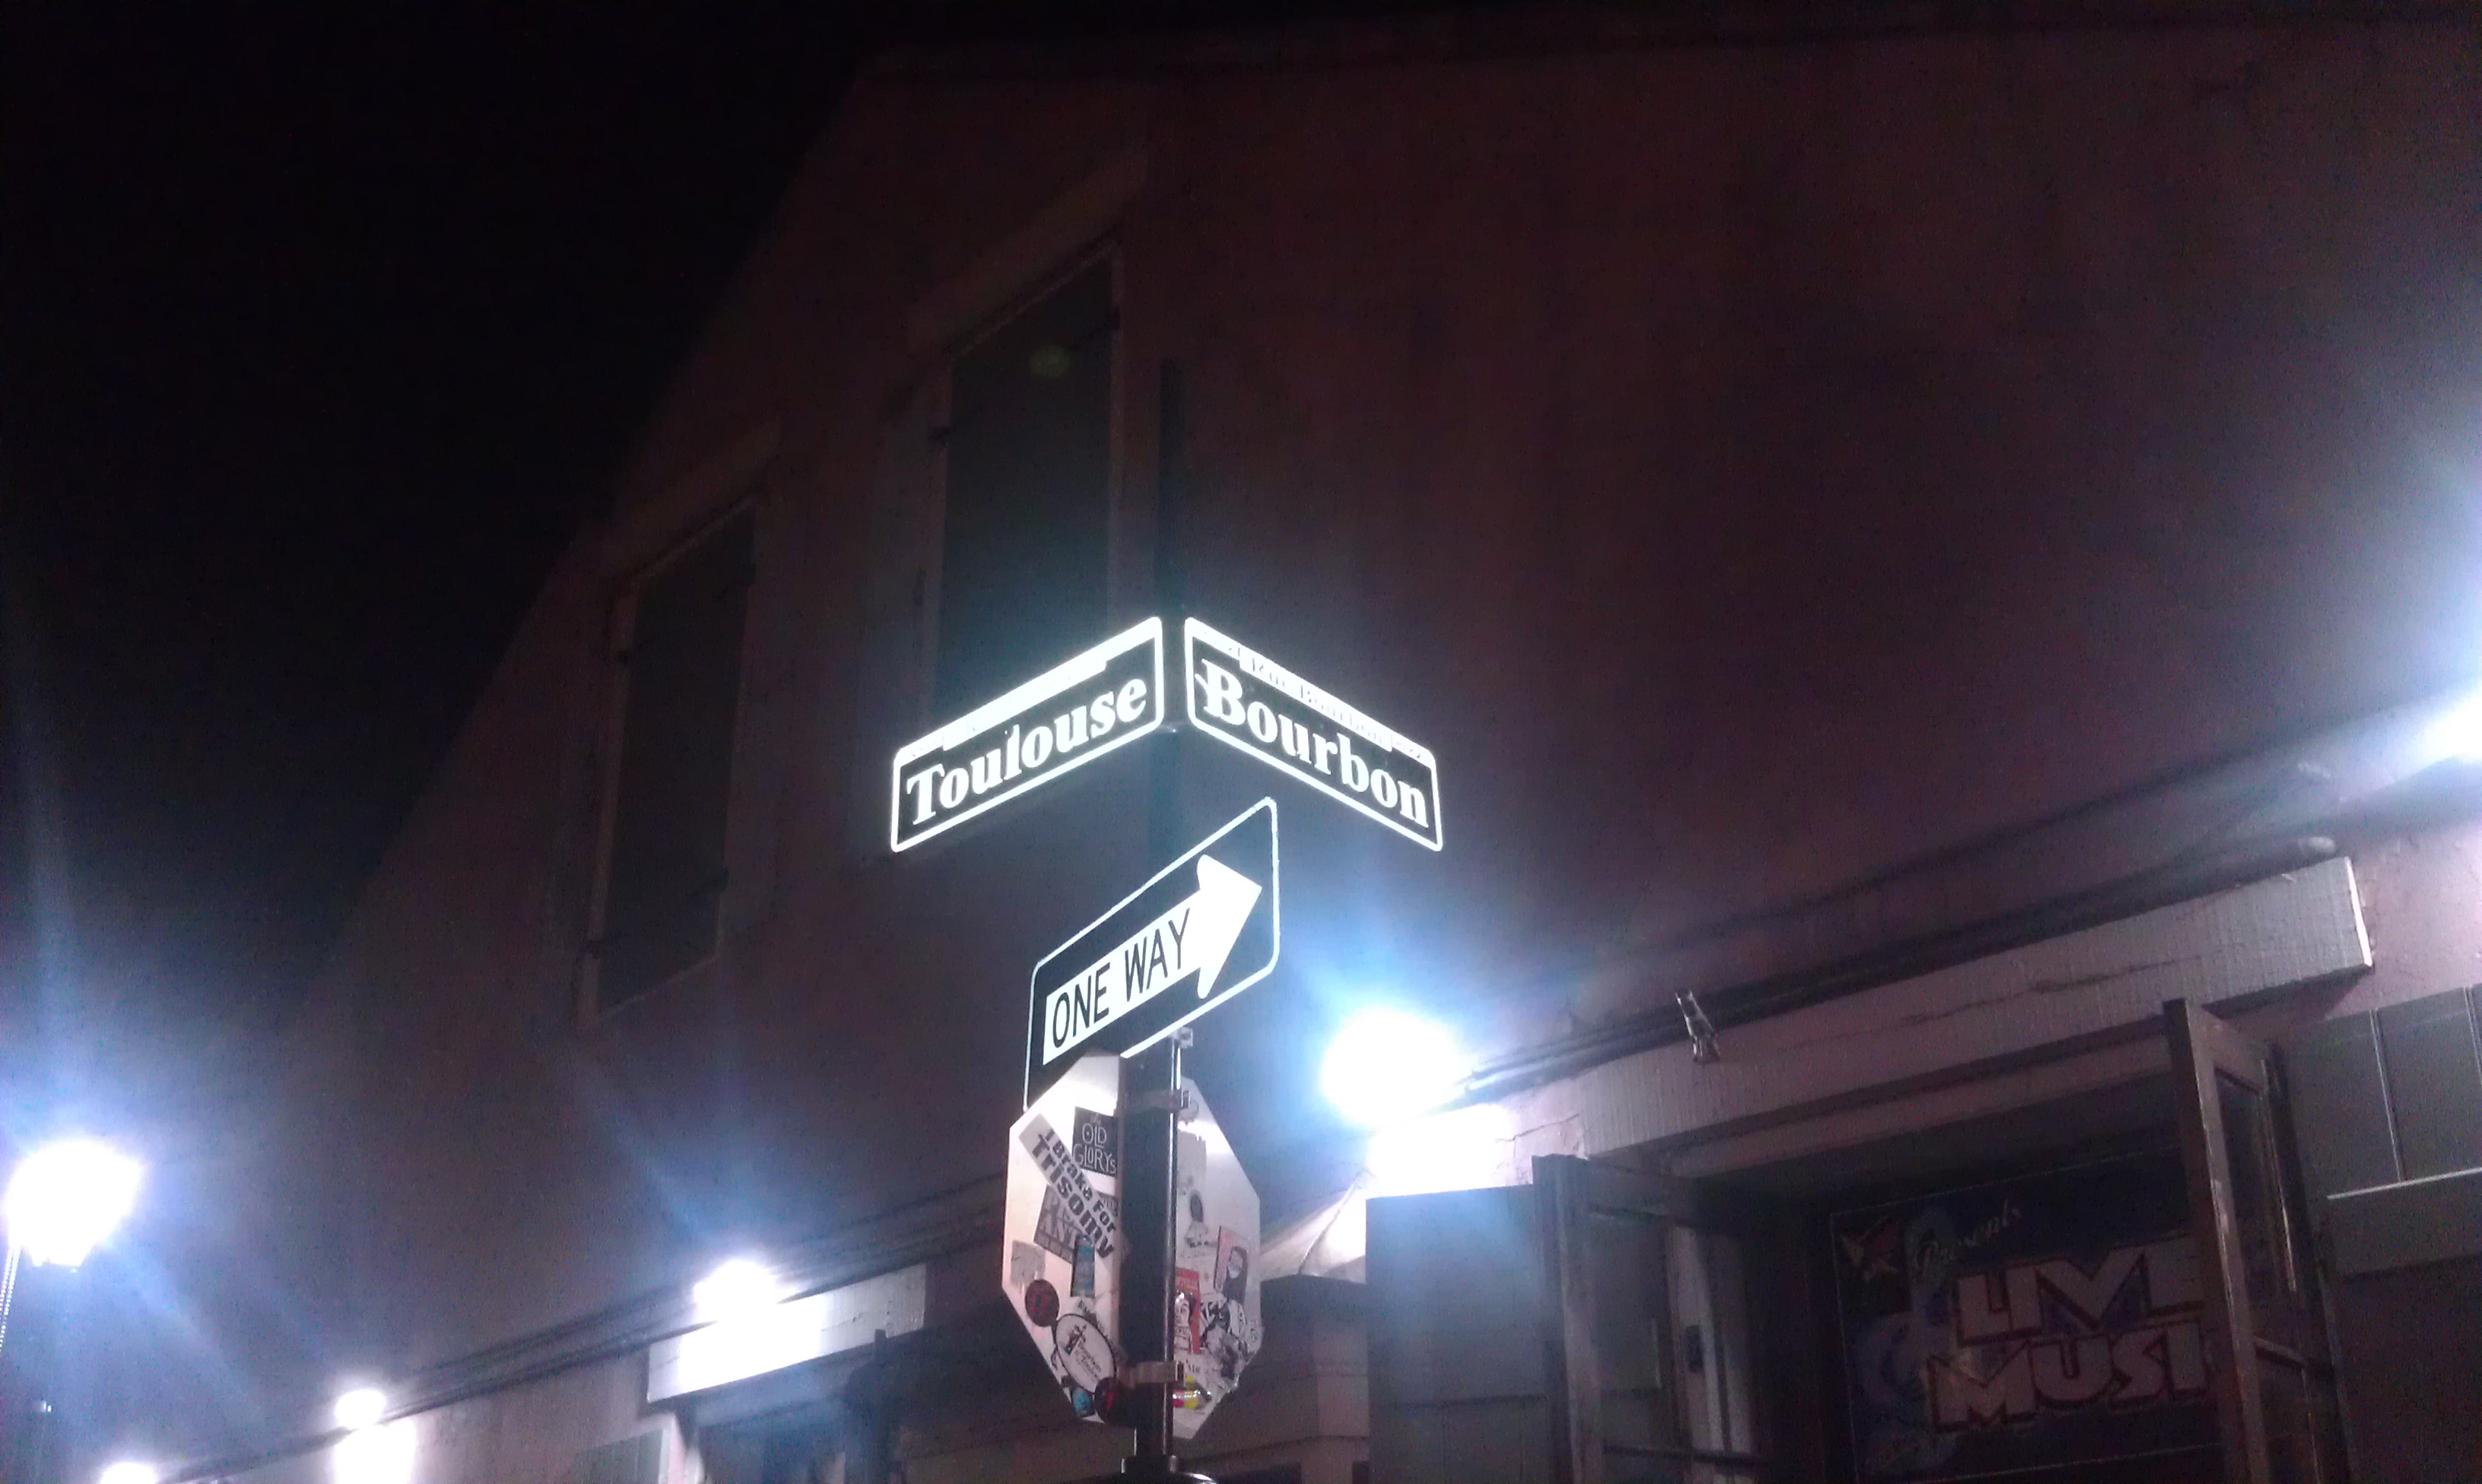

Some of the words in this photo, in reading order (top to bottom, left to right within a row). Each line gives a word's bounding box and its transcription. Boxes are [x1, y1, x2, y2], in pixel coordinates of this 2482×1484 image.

[906, 678, 1147, 826] Toulouse
[1195, 658, 1430, 829] Bourbon
[1052, 961, 1111, 1049] ONE
[1124, 907, 1191, 1003] WAY
[1044, 1129, 1055, 1142] I
[1052, 1140, 1093, 1201] Brake
[1093, 1199, 1116, 1233] For
[1081, 1123, 1107, 1149] OLD
[1031, 1134, 1115, 1259] Trisomy
[1955, 1235, 2207, 1343] LIVE
[1928, 1319, 2211, 1428] MUSI
